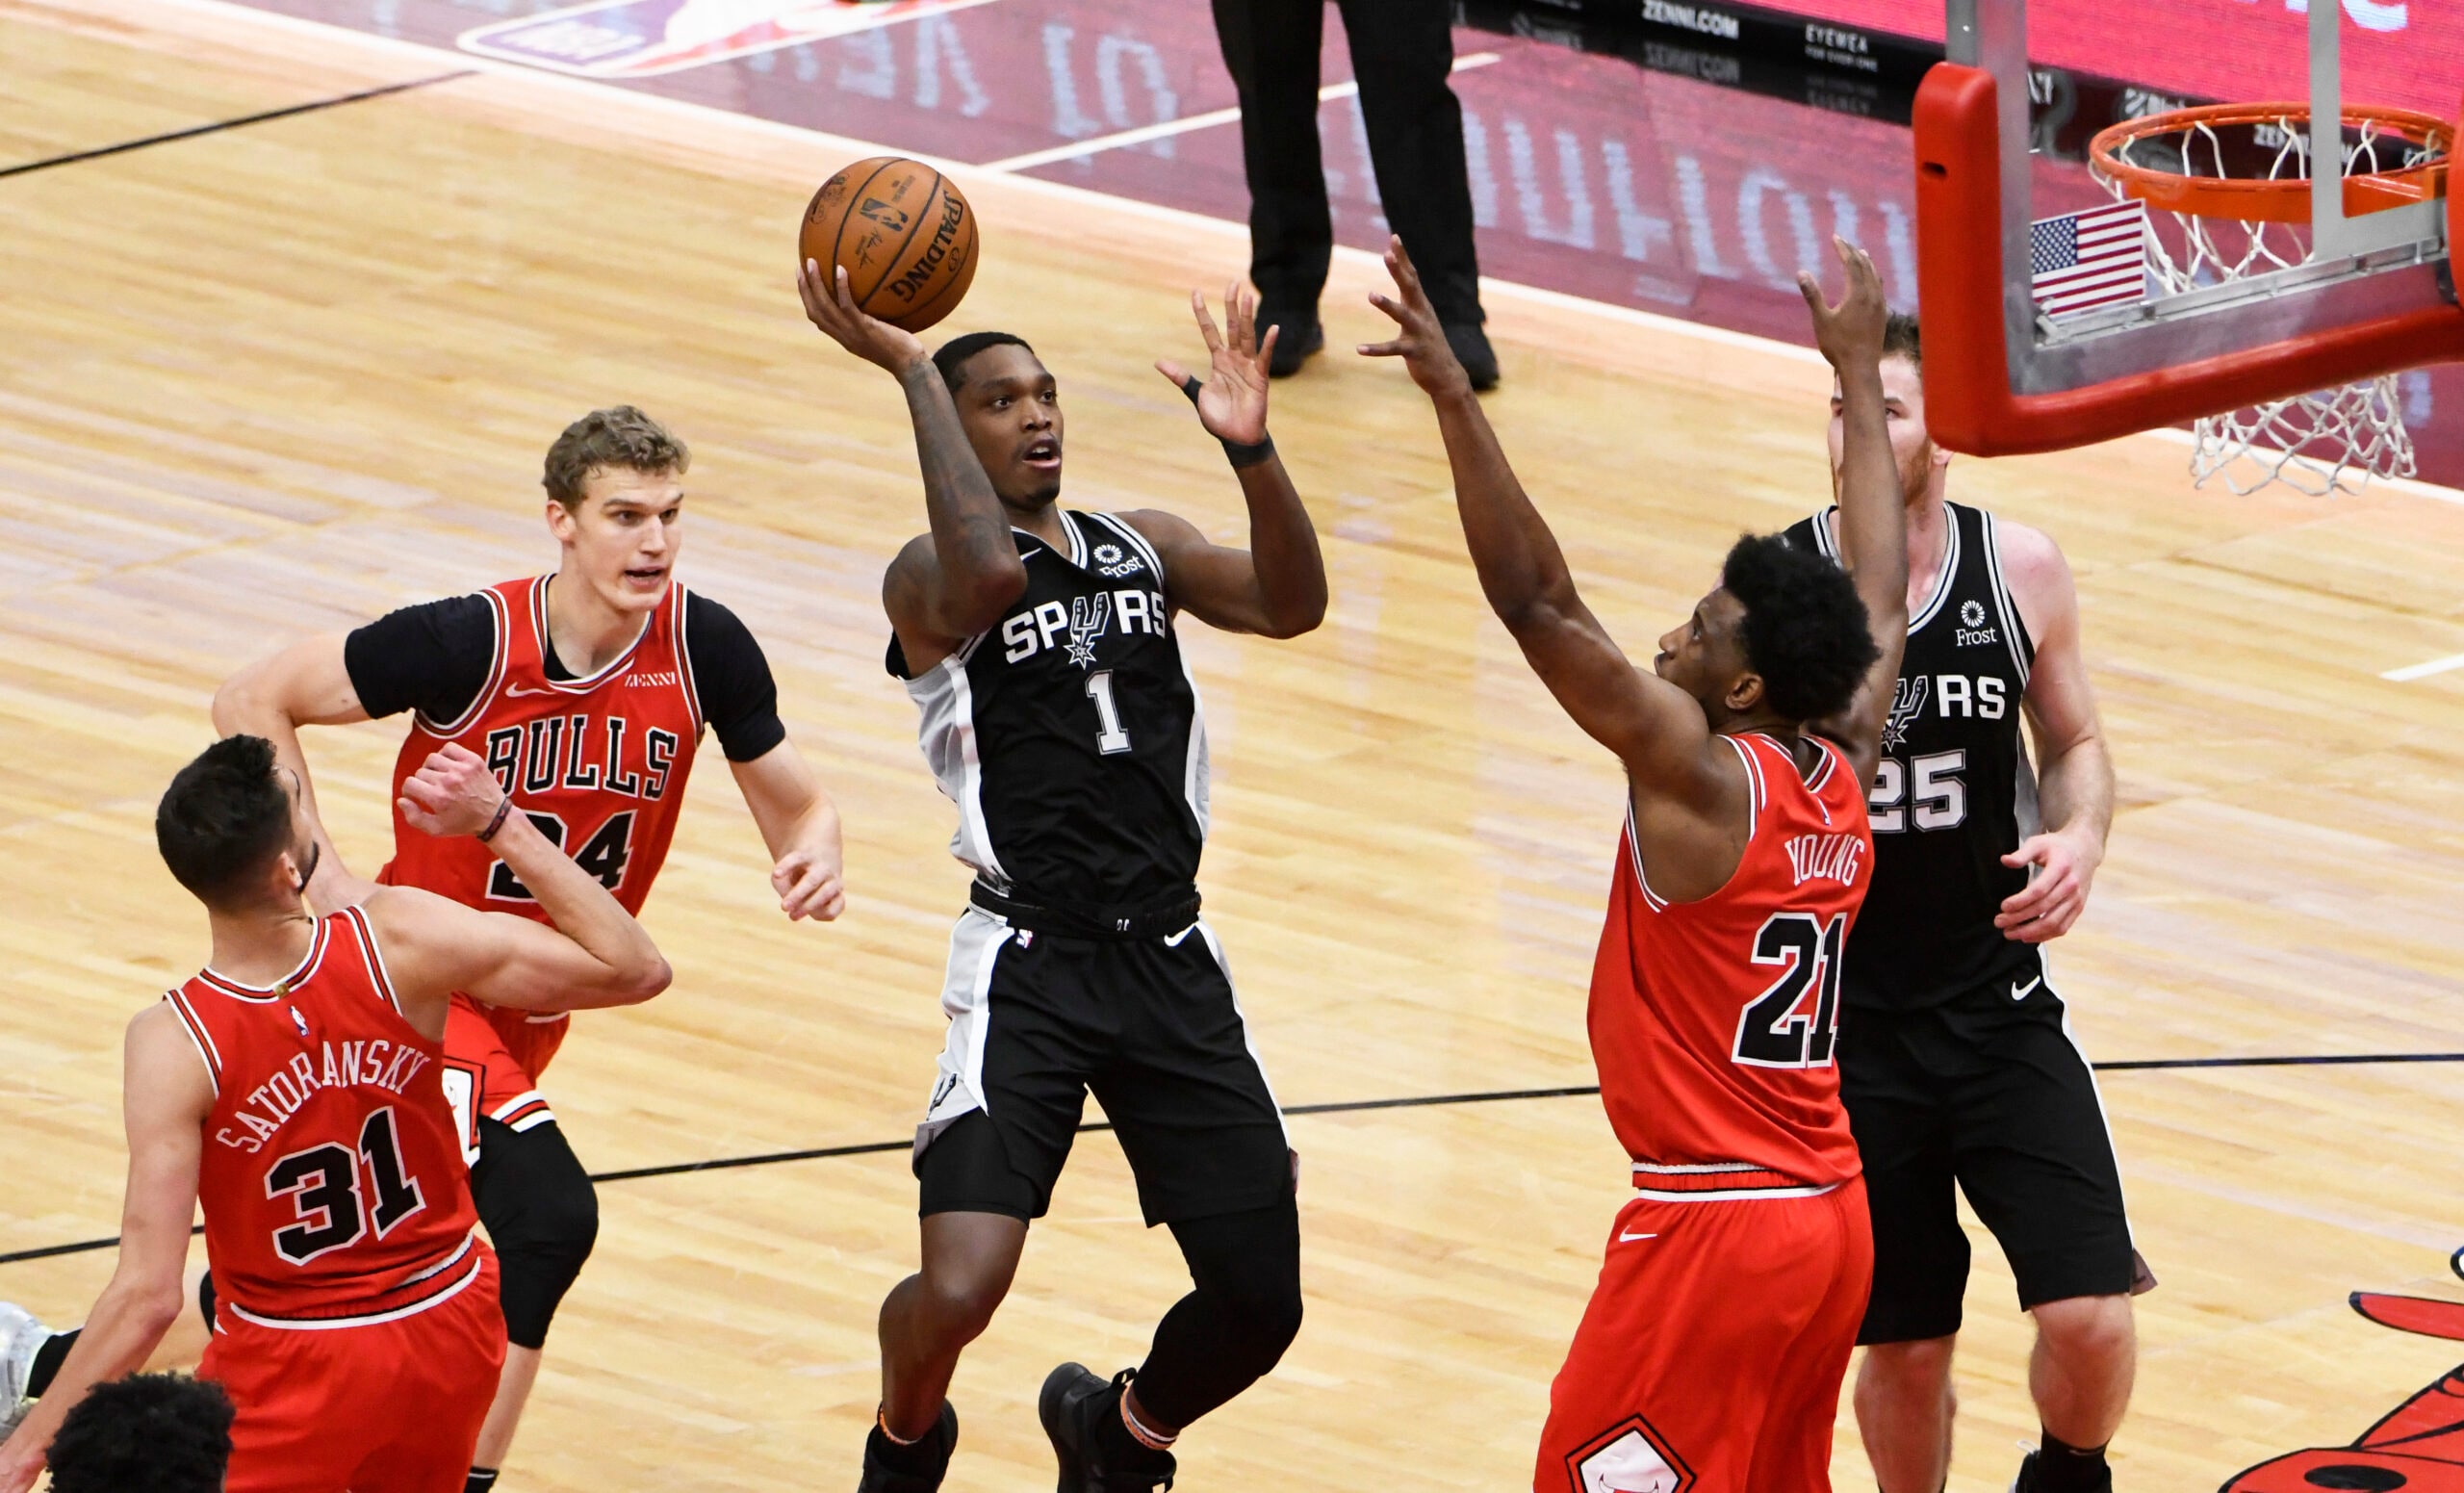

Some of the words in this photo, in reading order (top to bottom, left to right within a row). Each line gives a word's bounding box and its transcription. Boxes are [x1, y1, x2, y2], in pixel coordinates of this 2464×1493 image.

[885, 190, 963, 303] SPALDING
[624, 671, 676, 687] ZENNI
[1956, 627, 1997, 647] Frost
[1085, 669, 1132, 756] 1
[486, 714, 678, 801] BULLS
[1868, 748, 1967, 833] 25
[1784, 834, 1864, 887] YOUNG
[1731, 912, 1847, 1068] 21
[216, 1040, 430, 1153] SATORANSKY
[264, 1105, 426, 1267] 31
